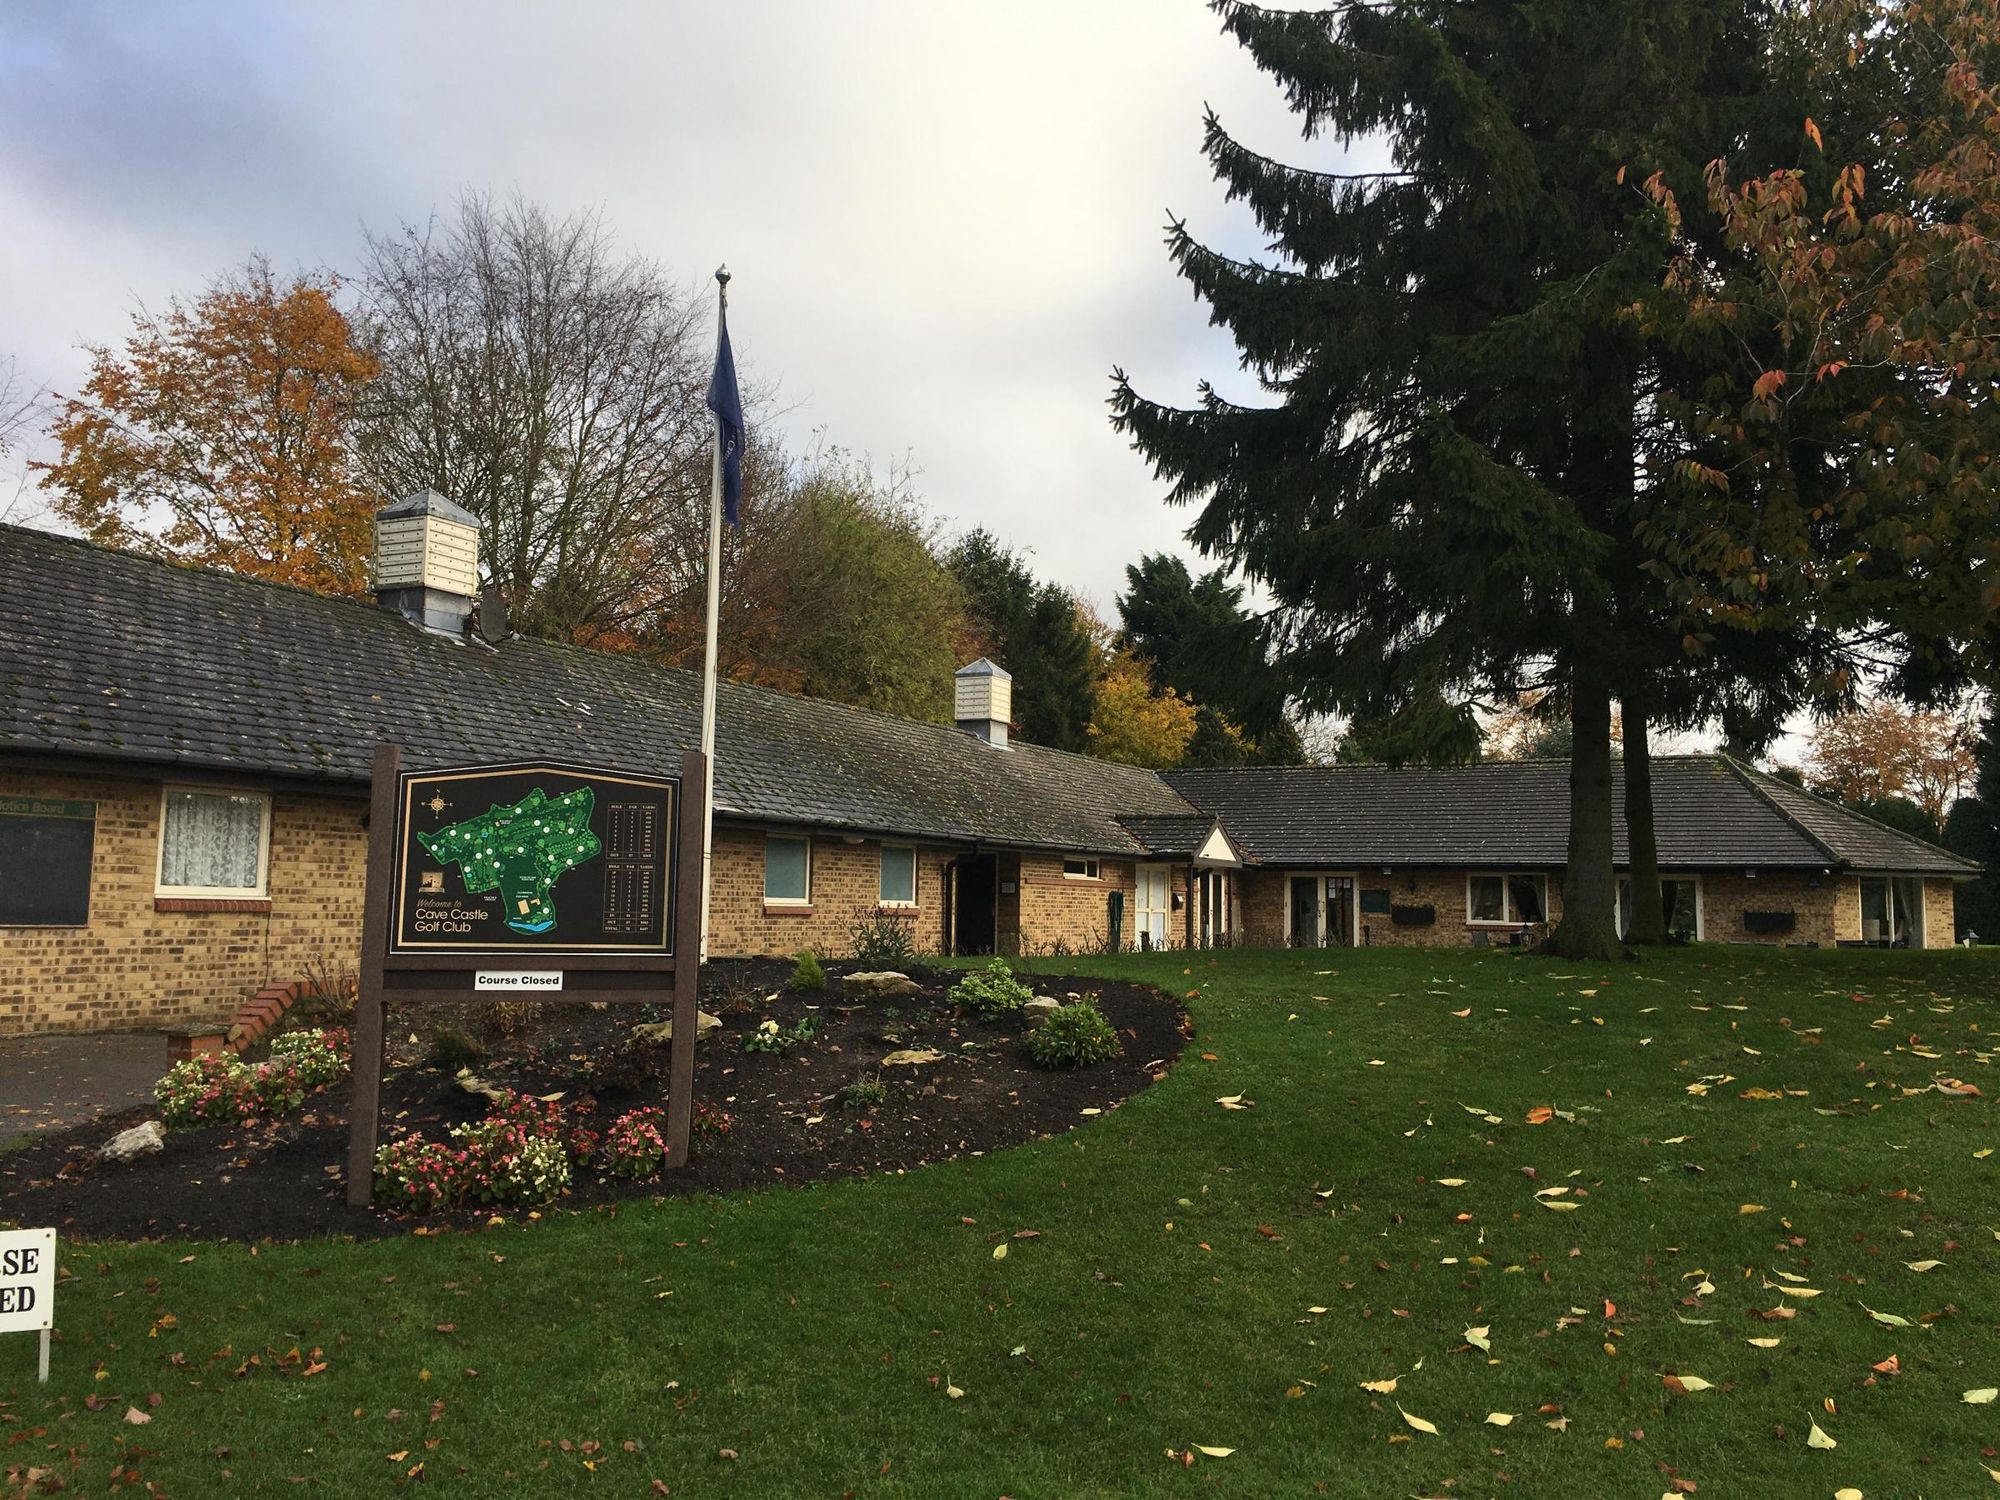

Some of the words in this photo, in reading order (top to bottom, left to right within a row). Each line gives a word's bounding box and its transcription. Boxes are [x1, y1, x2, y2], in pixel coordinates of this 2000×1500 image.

[32, 802, 65, 814] Board
[416, 898, 452, 908] Welcome
[453, 899, 462, 908] to
[415, 908, 448, 920] Cave
[450, 908, 489, 920] Castle
[414, 921, 440, 932] Golf
[442, 921, 472, 932] Club
[478, 975, 518, 985] Course
[521, 975, 560, 985] Closed
[0, 1248, 39, 1276] SE
[0, 1286, 36, 1314] ED
